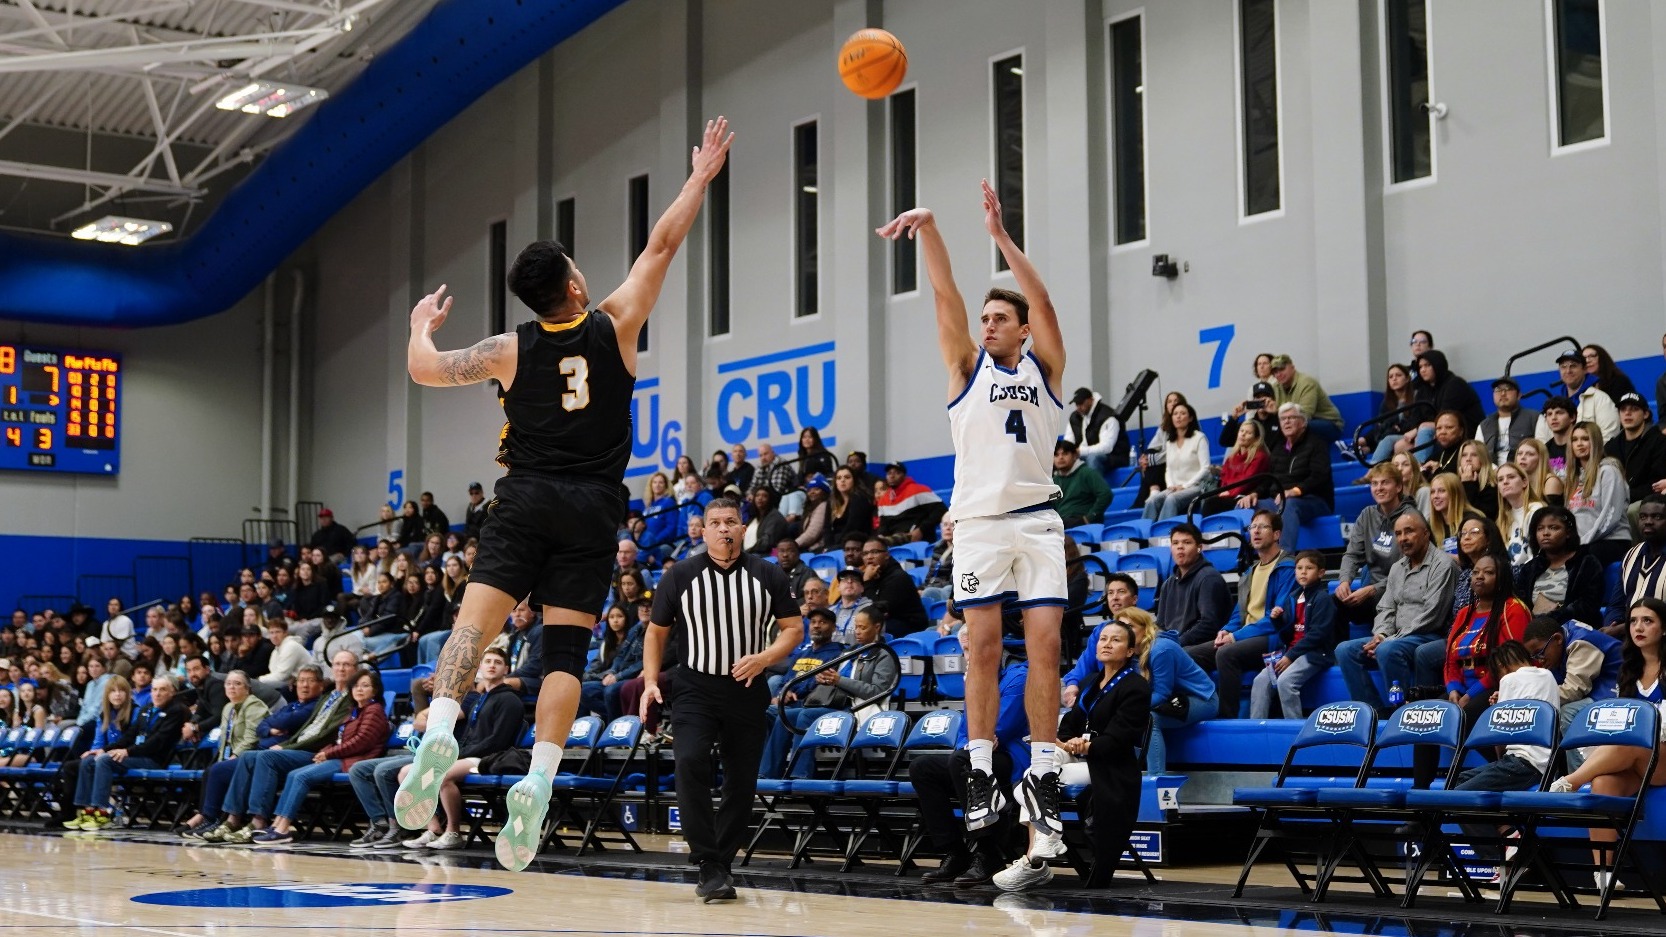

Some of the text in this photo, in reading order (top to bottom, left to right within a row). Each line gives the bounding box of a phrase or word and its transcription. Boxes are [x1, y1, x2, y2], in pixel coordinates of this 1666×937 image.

[1199, 323, 1235, 389] 7
[44, 366, 59, 392] 7
[558, 354, 590, 412] 3
[717, 359, 836, 445] CRU
[6, 427, 52, 450] 4 3
[1004, 409, 1028, 444] 4
[661, 420, 683, 469] 6
[388, 469, 404, 512] 5
[1319, 710, 1357, 725] CSUSM
[1402, 709, 1444, 725] CSUSM
[1492, 708, 1536, 724] CSUSM
